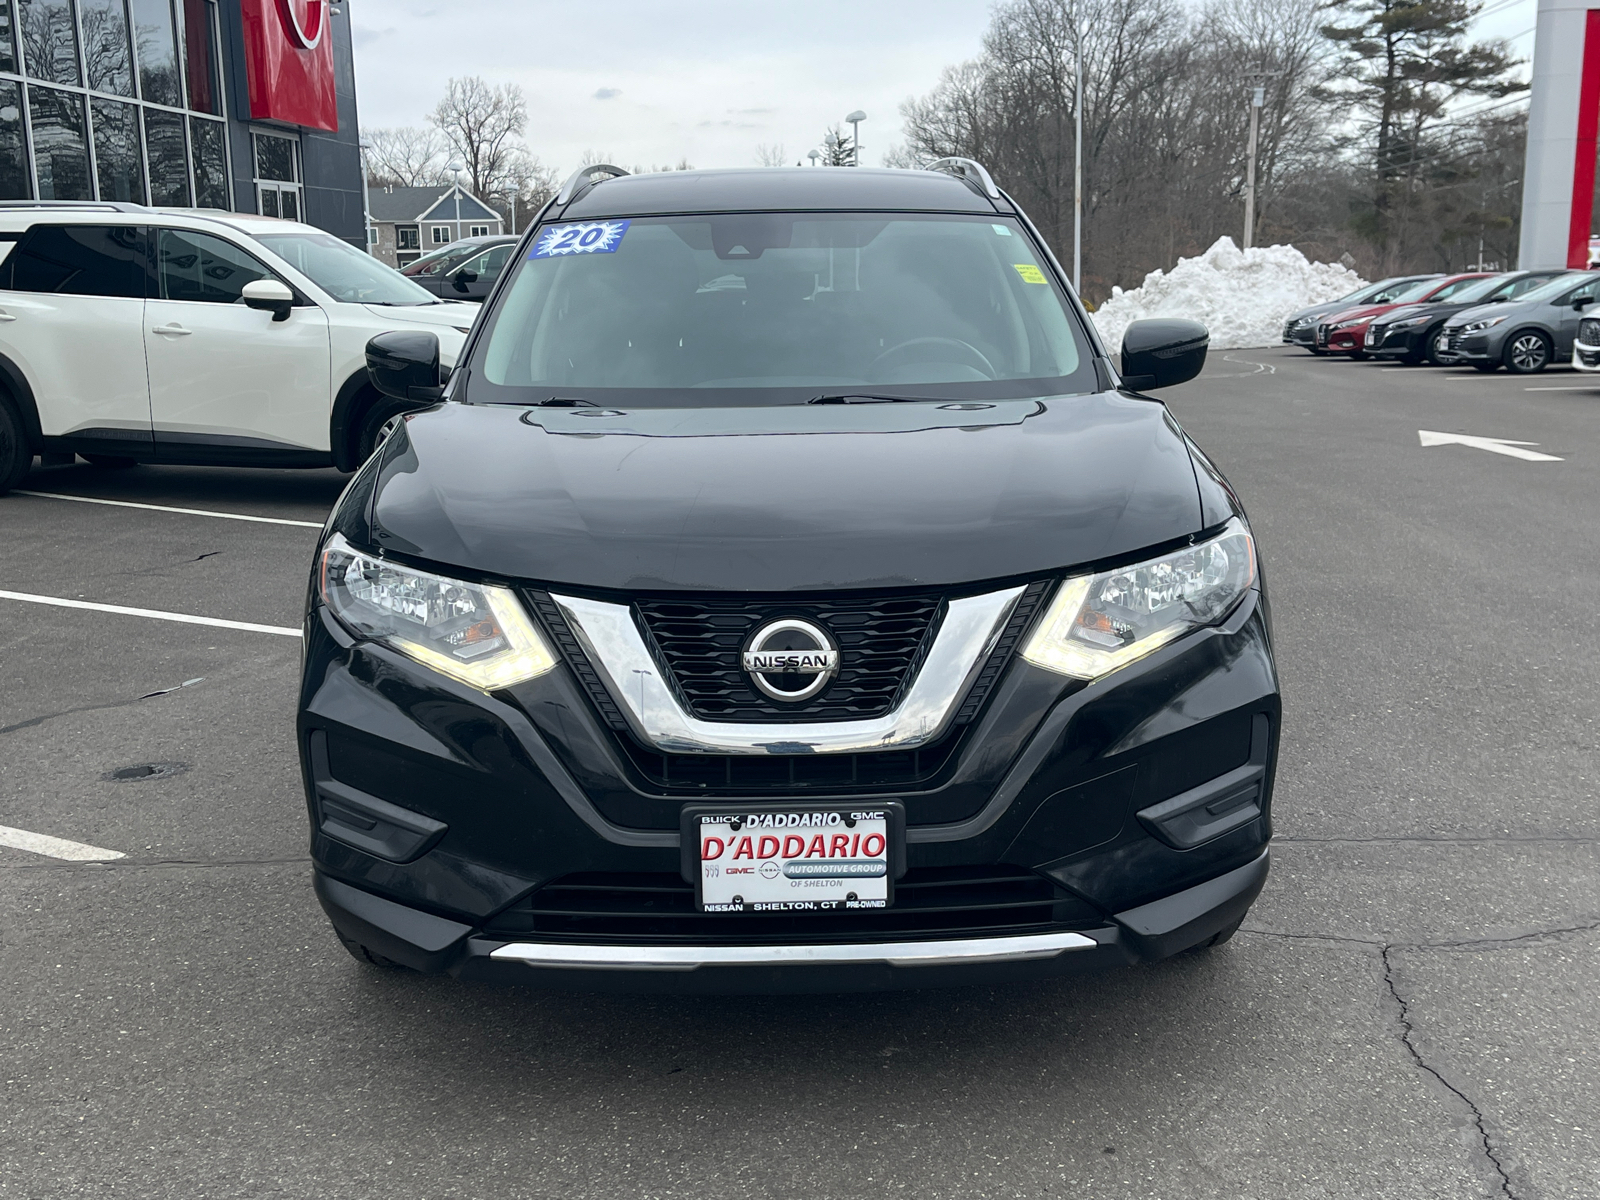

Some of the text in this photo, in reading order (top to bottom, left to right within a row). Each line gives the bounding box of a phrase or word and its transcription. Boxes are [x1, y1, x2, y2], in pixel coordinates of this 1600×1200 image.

[552, 227, 604, 250] 20
[753, 655, 827, 667] NISSAN
[701, 811, 884, 829] BUICK D'ADDARIO GMC
[701, 832, 886, 861] D'ADDARIO
[788, 864, 883, 874] AUTOMOTIVE GROUP
[790, 879, 843, 888] OF SHELTON
[704, 900, 886, 912] NISSAN SHELTON, CT PRE-OWNED
